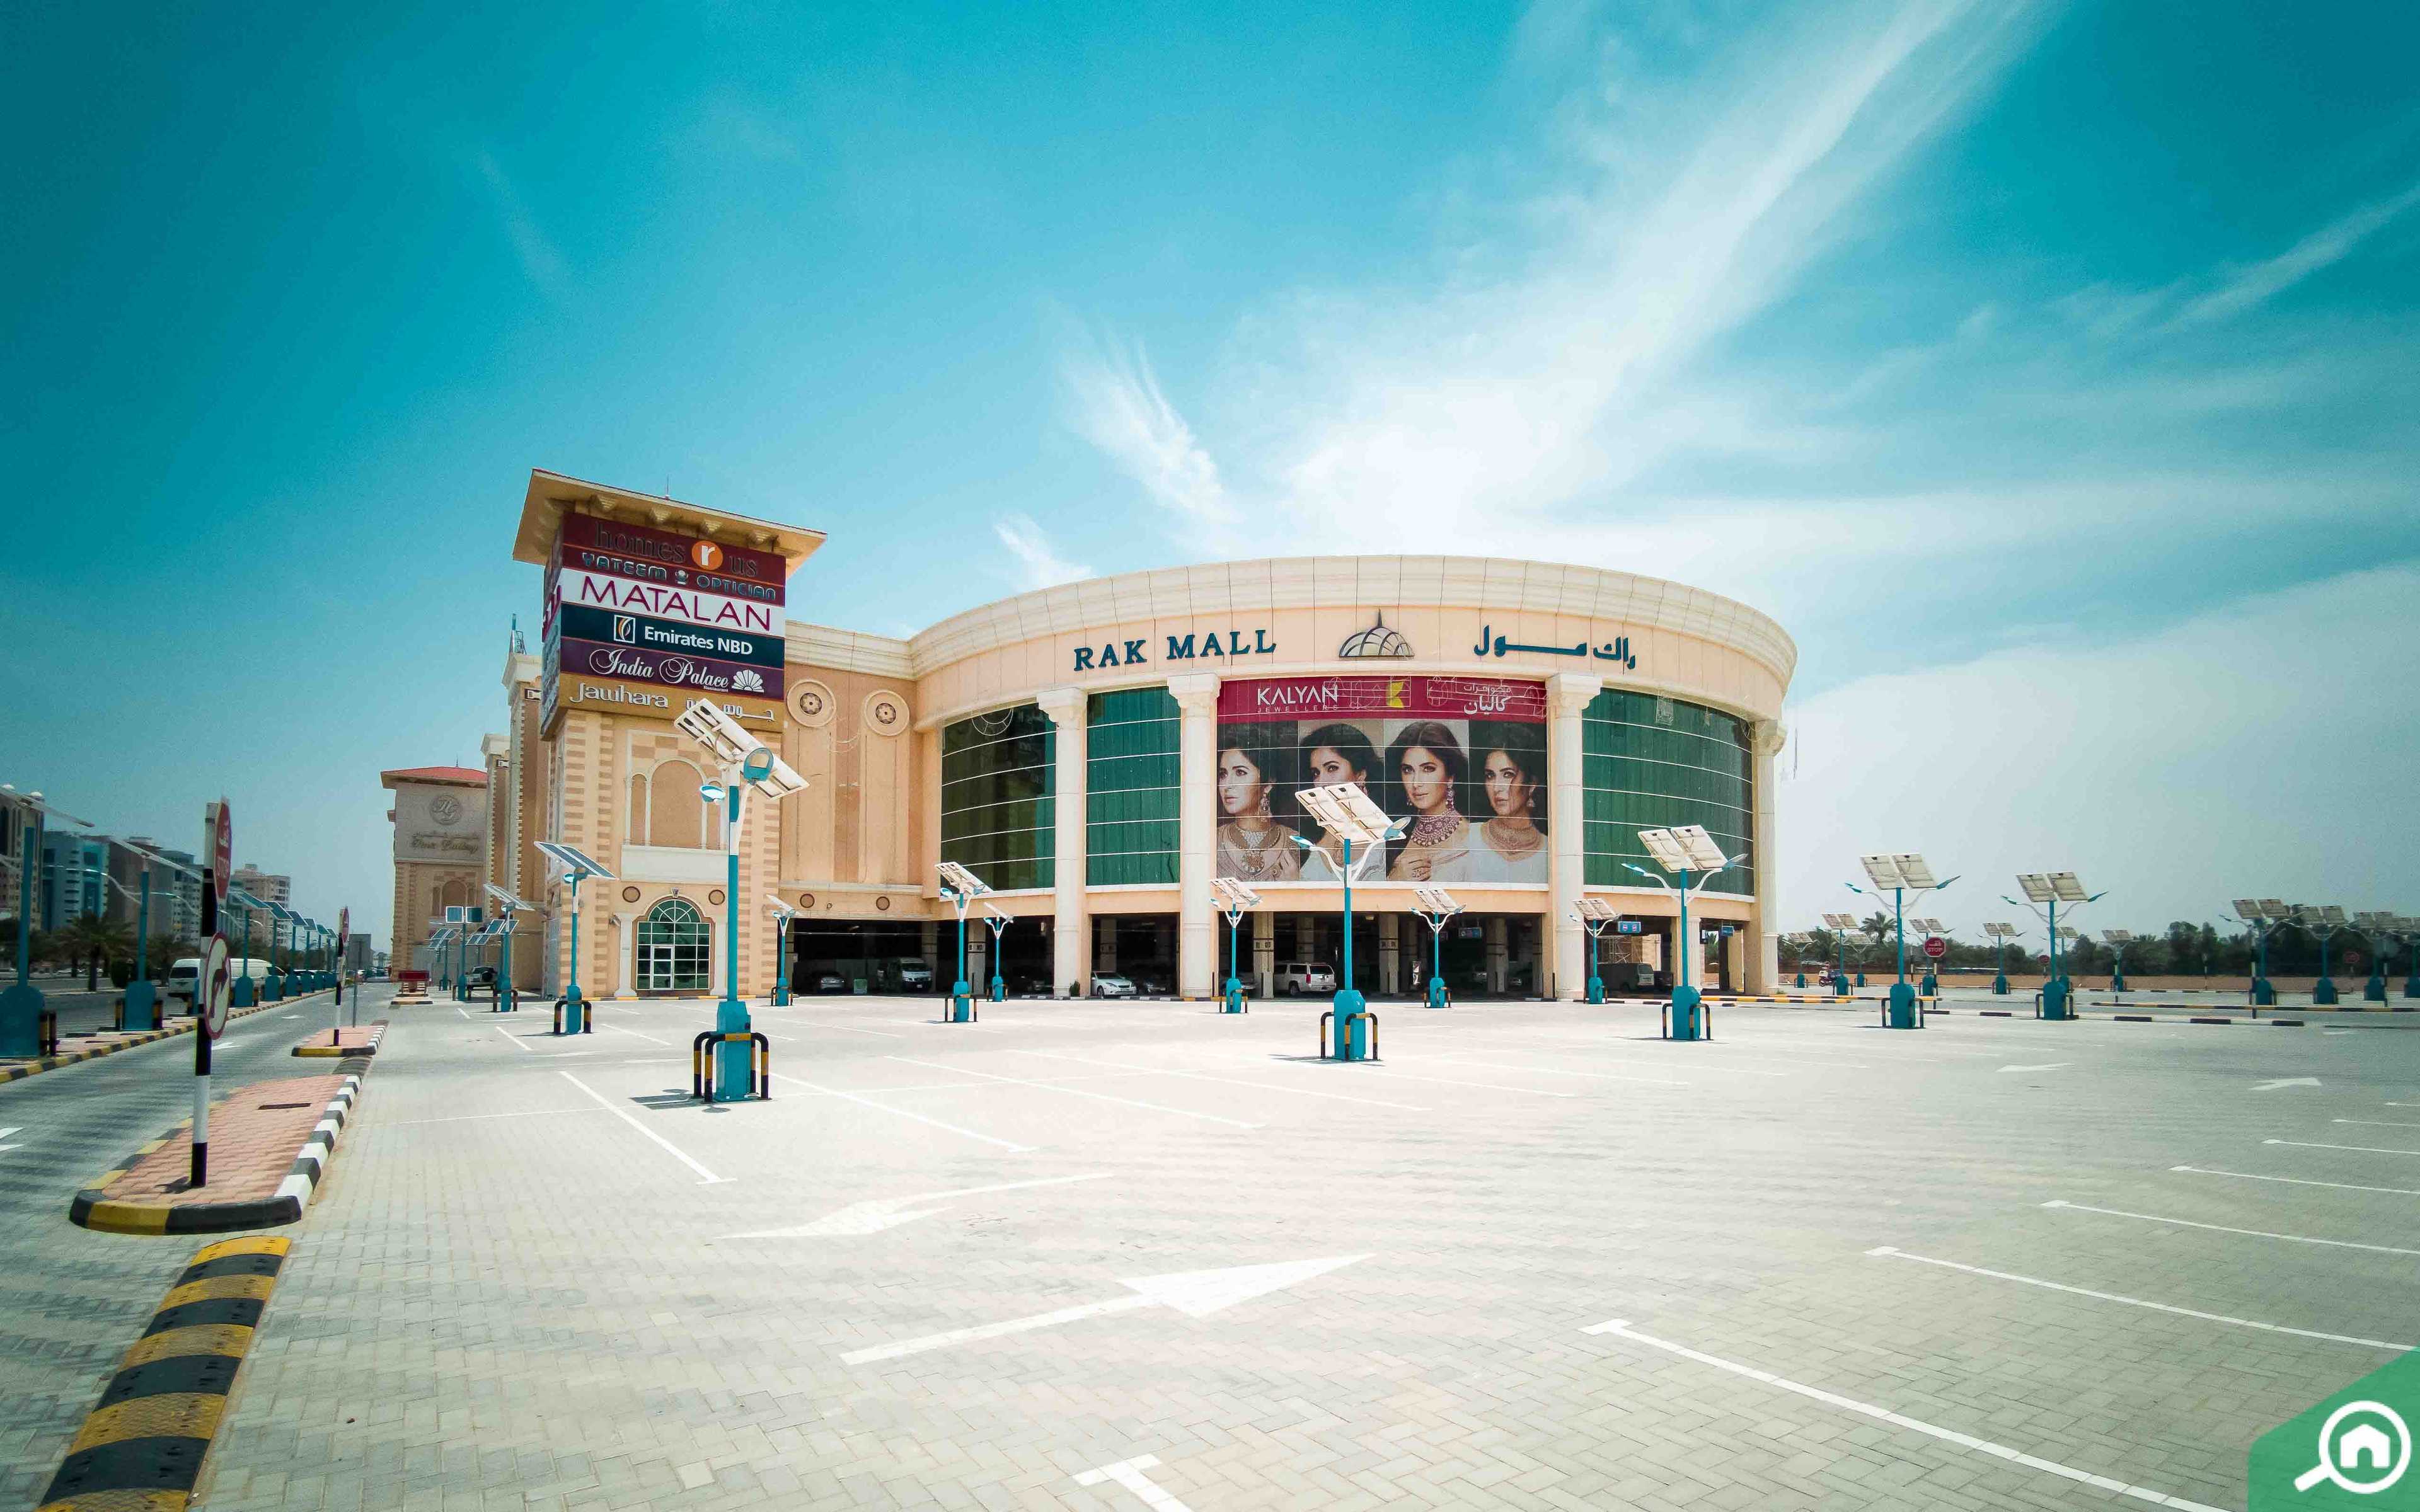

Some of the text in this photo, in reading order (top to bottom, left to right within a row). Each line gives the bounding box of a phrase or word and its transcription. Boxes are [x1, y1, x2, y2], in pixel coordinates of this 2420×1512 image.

[595, 523, 686, 564] homes
[729, 555, 757, 577] us
[582, 552, 776, 600] YATEEM OPTICIAN
[581, 576, 770, 631] MATALAN
[645, 626, 752, 656] Emirates NBD
[1073, 629, 1277, 672] RAK MALL
[1593, 635, 1636, 670] راك
[589, 649, 729, 688] India Palace
[570, 683, 669, 709] Jawhara
[1257, 685, 1338, 706] KALYAN
[1258, 705, 1338, 713] JEWELLERS
[1463, 694, 1512, 715] كاليان
